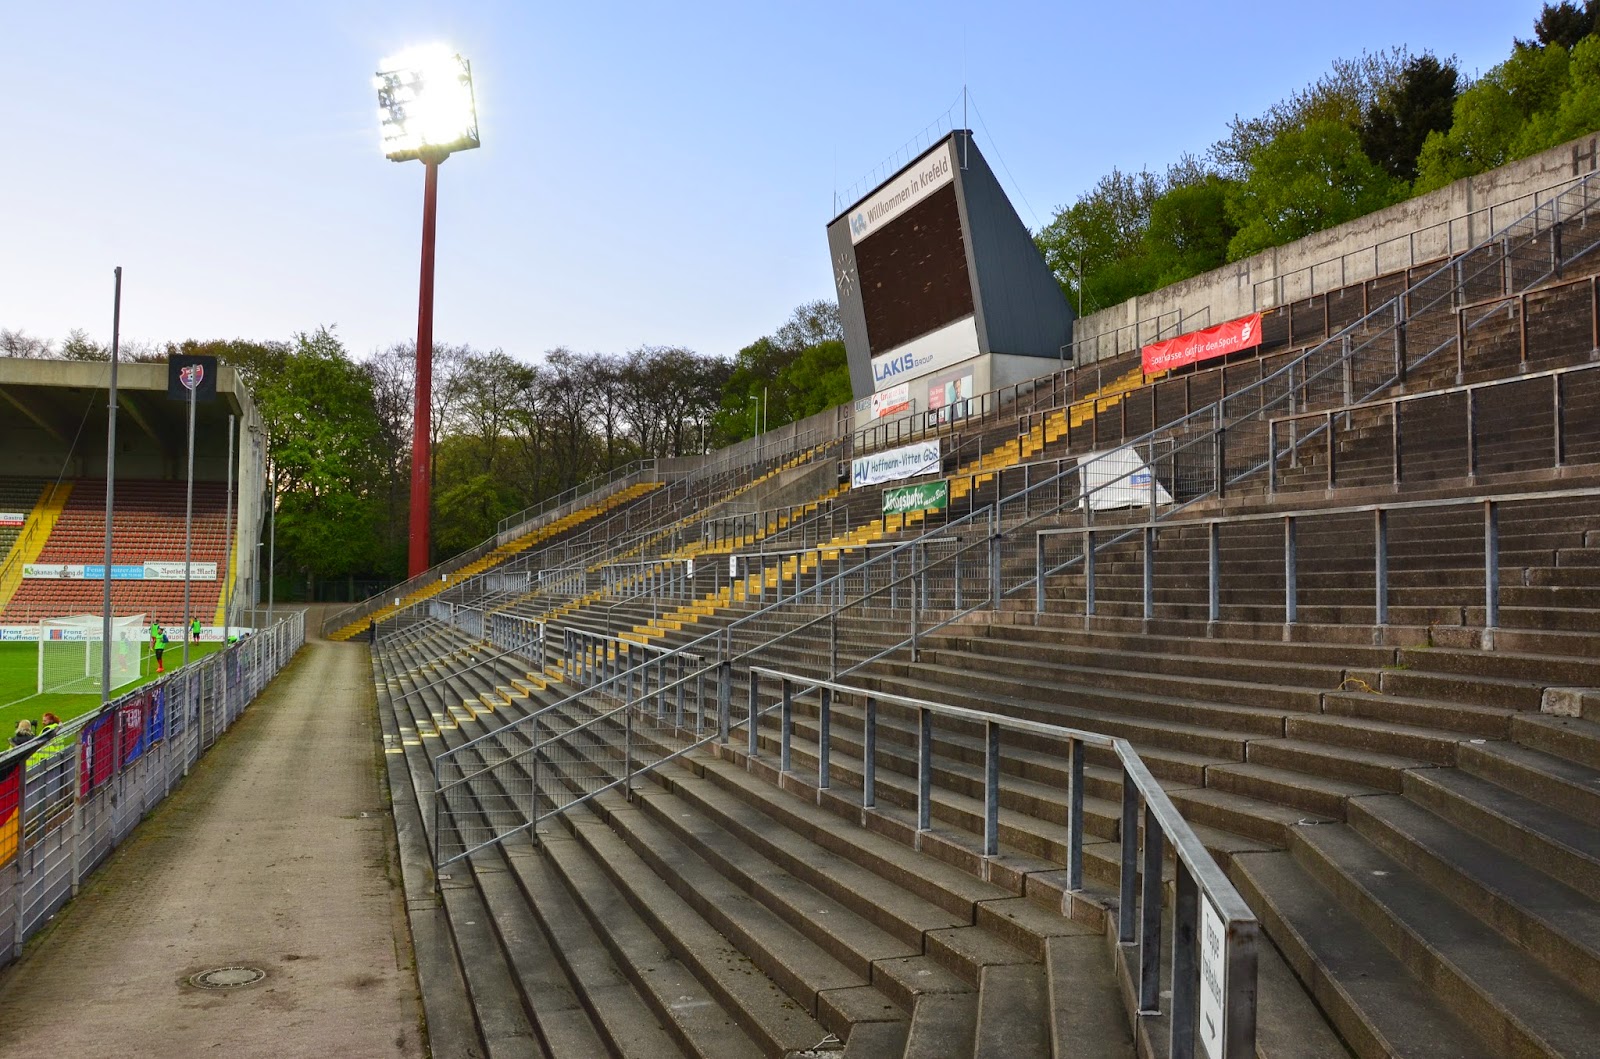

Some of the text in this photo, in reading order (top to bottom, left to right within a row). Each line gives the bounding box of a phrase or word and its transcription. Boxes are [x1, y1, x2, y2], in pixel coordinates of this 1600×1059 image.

[867, 156, 949, 224] Willkommen in Krefeld
[1151, 351, 1183, 366] Sparkasse.
[1205, 341, 1218, 351] den
[873, 353, 933, 381] LAKIS GROUP
[871, 447, 939, 472] Hoffmann-Vitten GbR
[854, 461, 870, 485] HV
